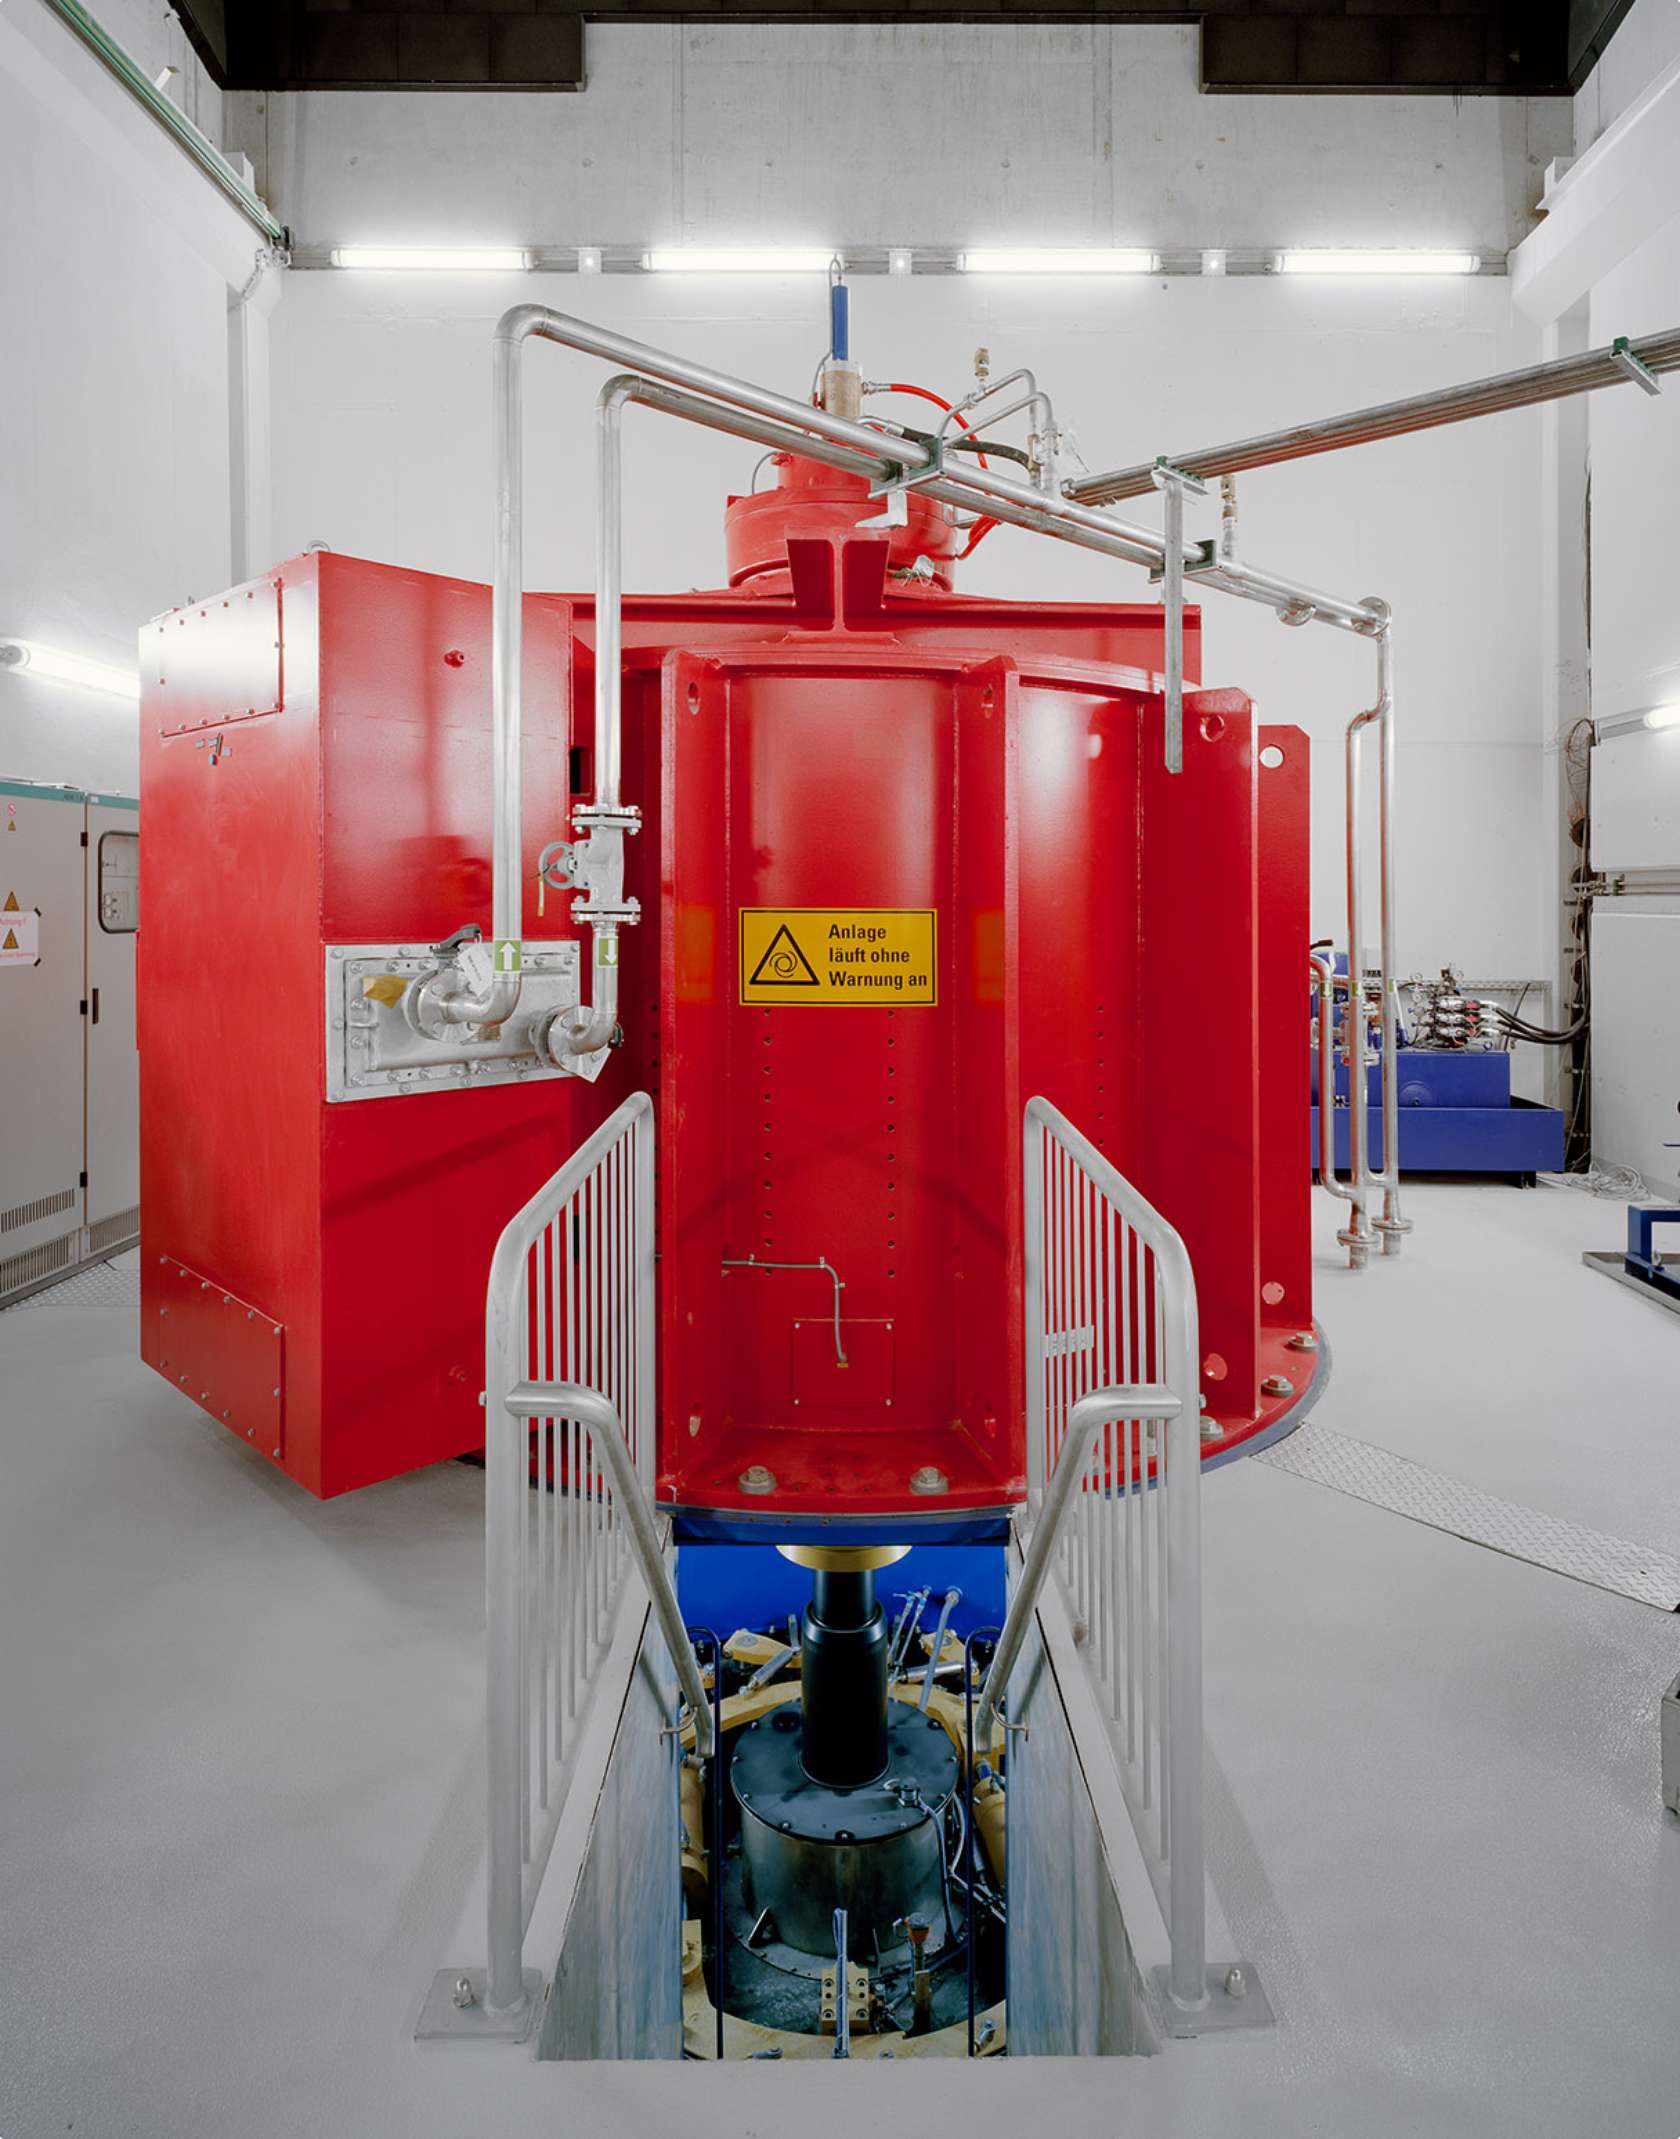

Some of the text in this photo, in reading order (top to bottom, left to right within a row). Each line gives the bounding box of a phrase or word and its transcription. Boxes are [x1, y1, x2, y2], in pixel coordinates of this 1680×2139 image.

[829, 924, 886, 942] Anlage
[829, 947, 909, 963] läuft ohne
[829, 971, 927, 990] Warnung an
